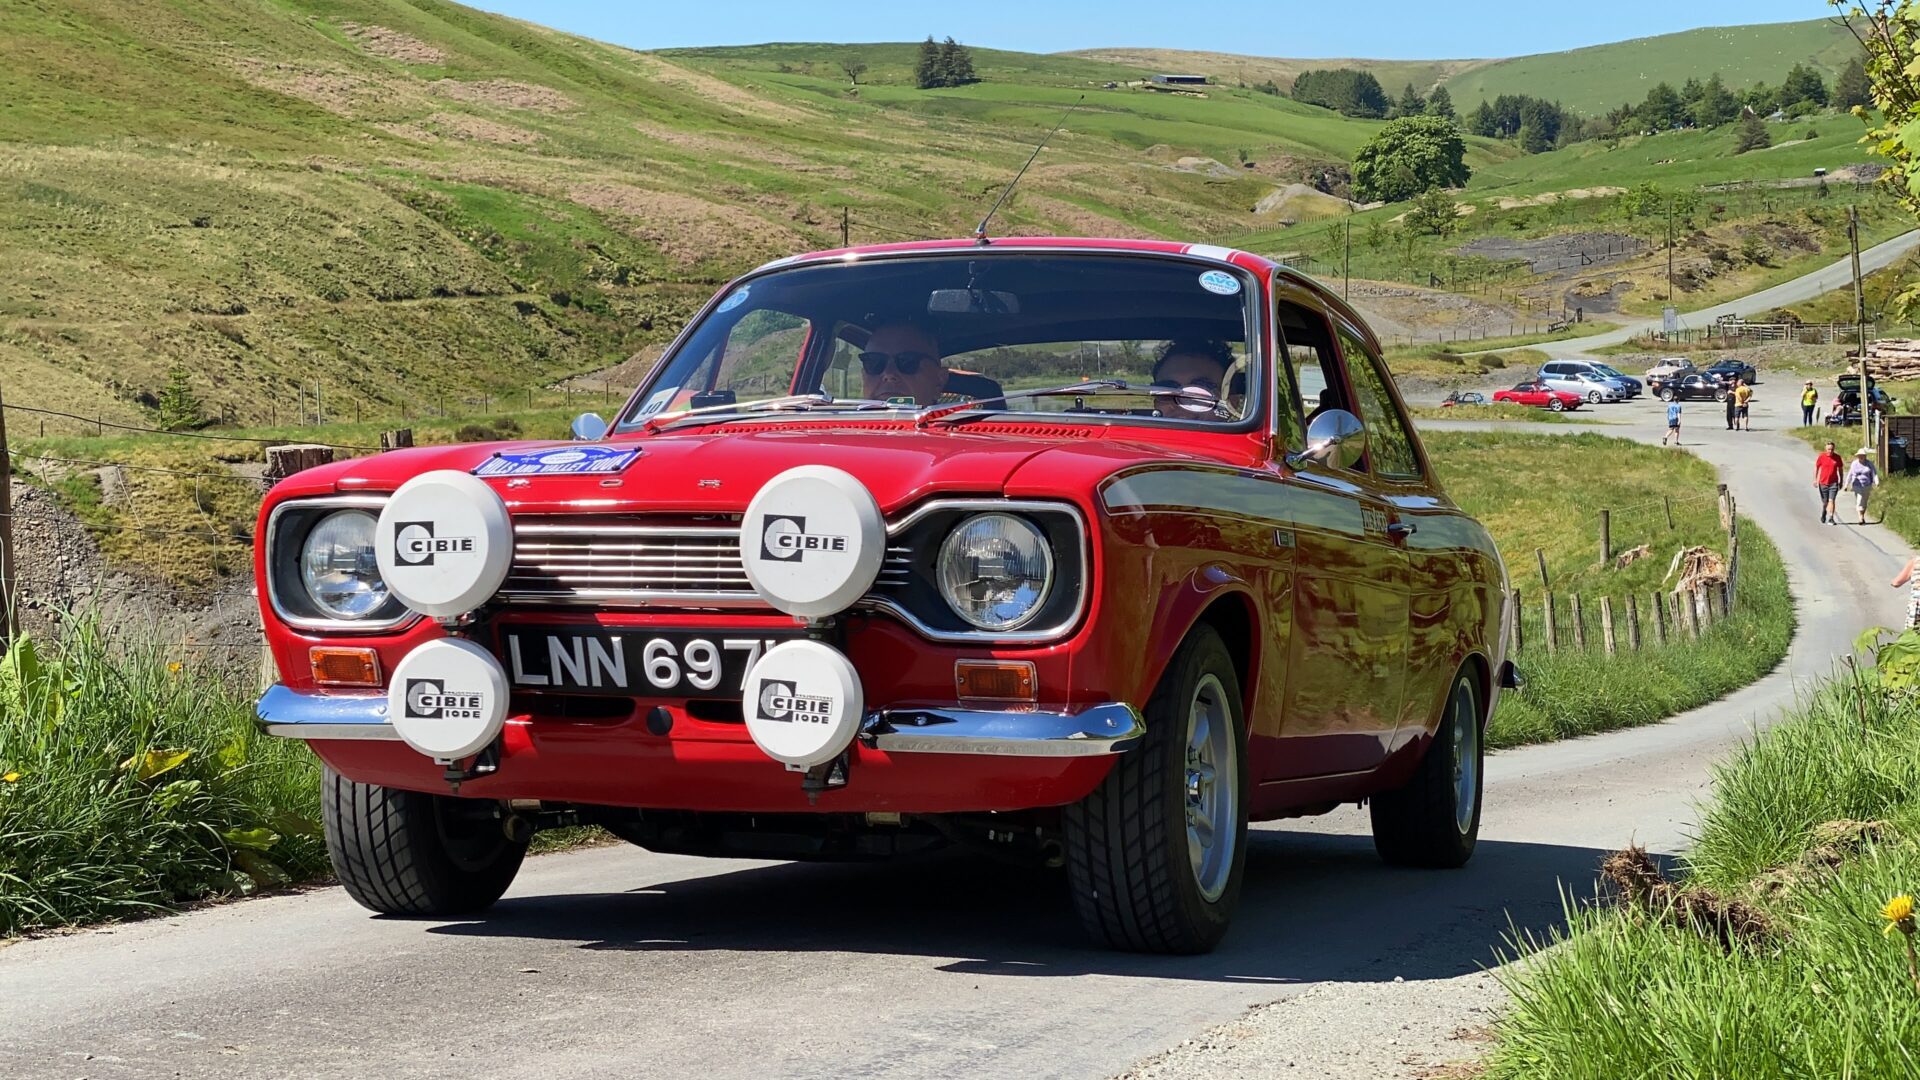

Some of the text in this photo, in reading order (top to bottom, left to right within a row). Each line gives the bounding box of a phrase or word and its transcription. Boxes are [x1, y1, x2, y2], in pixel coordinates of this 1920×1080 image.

[1203, 274, 1238, 288] AVO
[510, 463, 542, 474] AND
[539, 460, 590, 473] VALLEY
[508, 634, 777, 691] LNN 697
[445, 709, 481, 719] IODE
[795, 713, 830, 725] IODE
